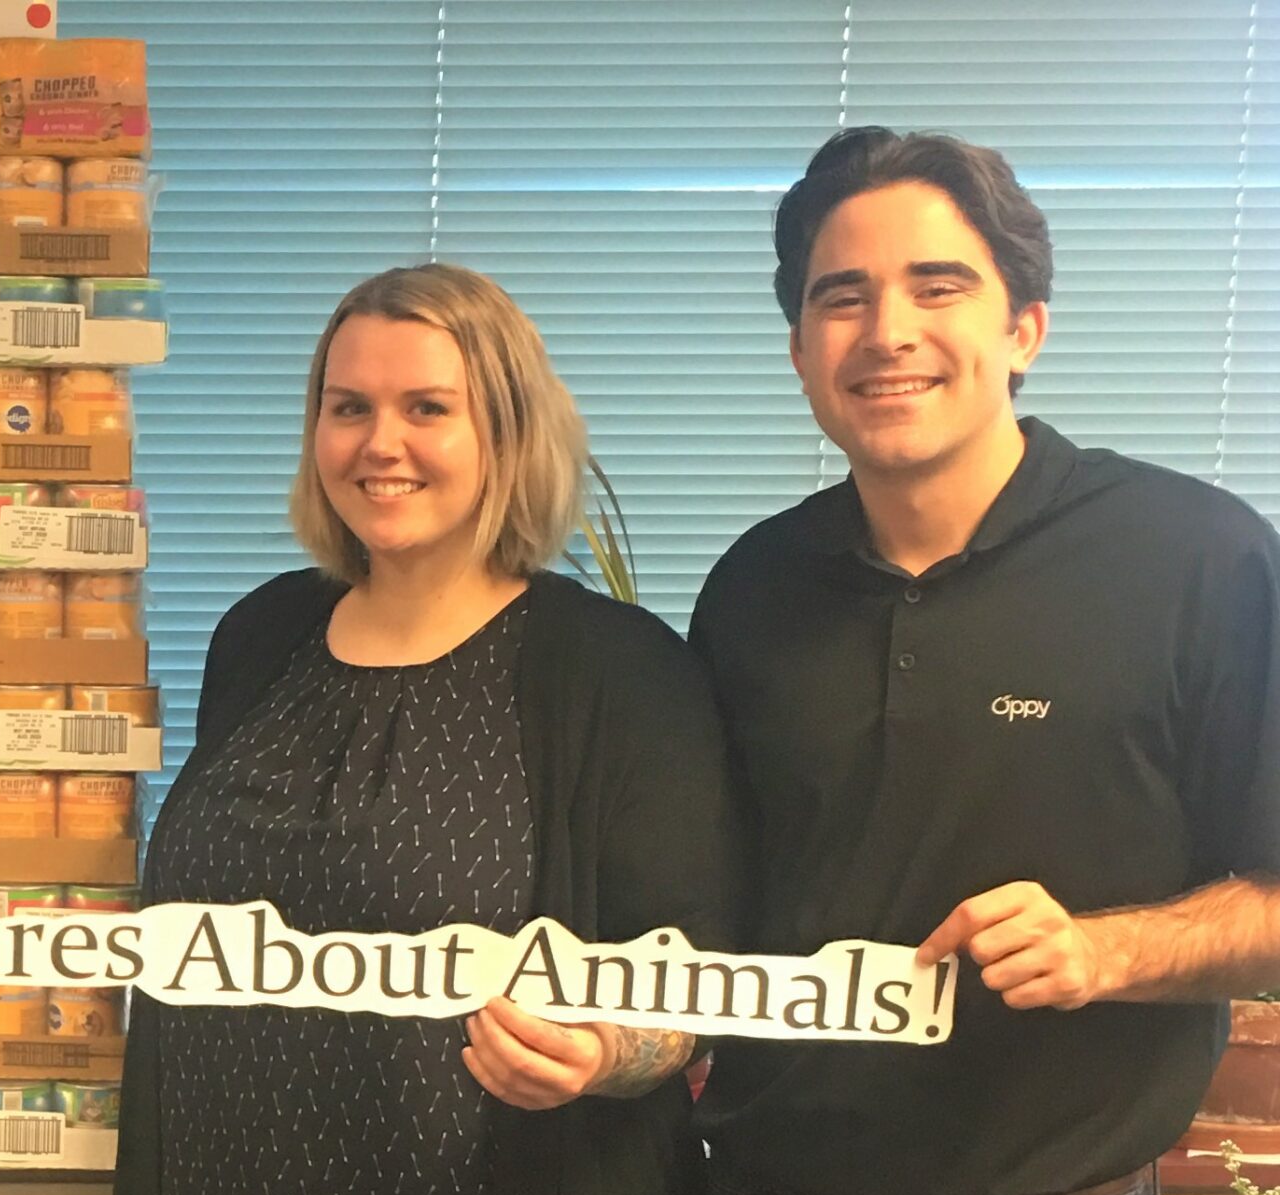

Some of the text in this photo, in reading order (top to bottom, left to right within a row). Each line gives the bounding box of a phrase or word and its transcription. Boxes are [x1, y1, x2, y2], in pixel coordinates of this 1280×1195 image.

[34, 76, 96, 92] CHOPPED
[991, 694, 1051, 722] Oppy
[162, 908, 474, 1000] About
[503, 926, 950, 1037] Animals!
